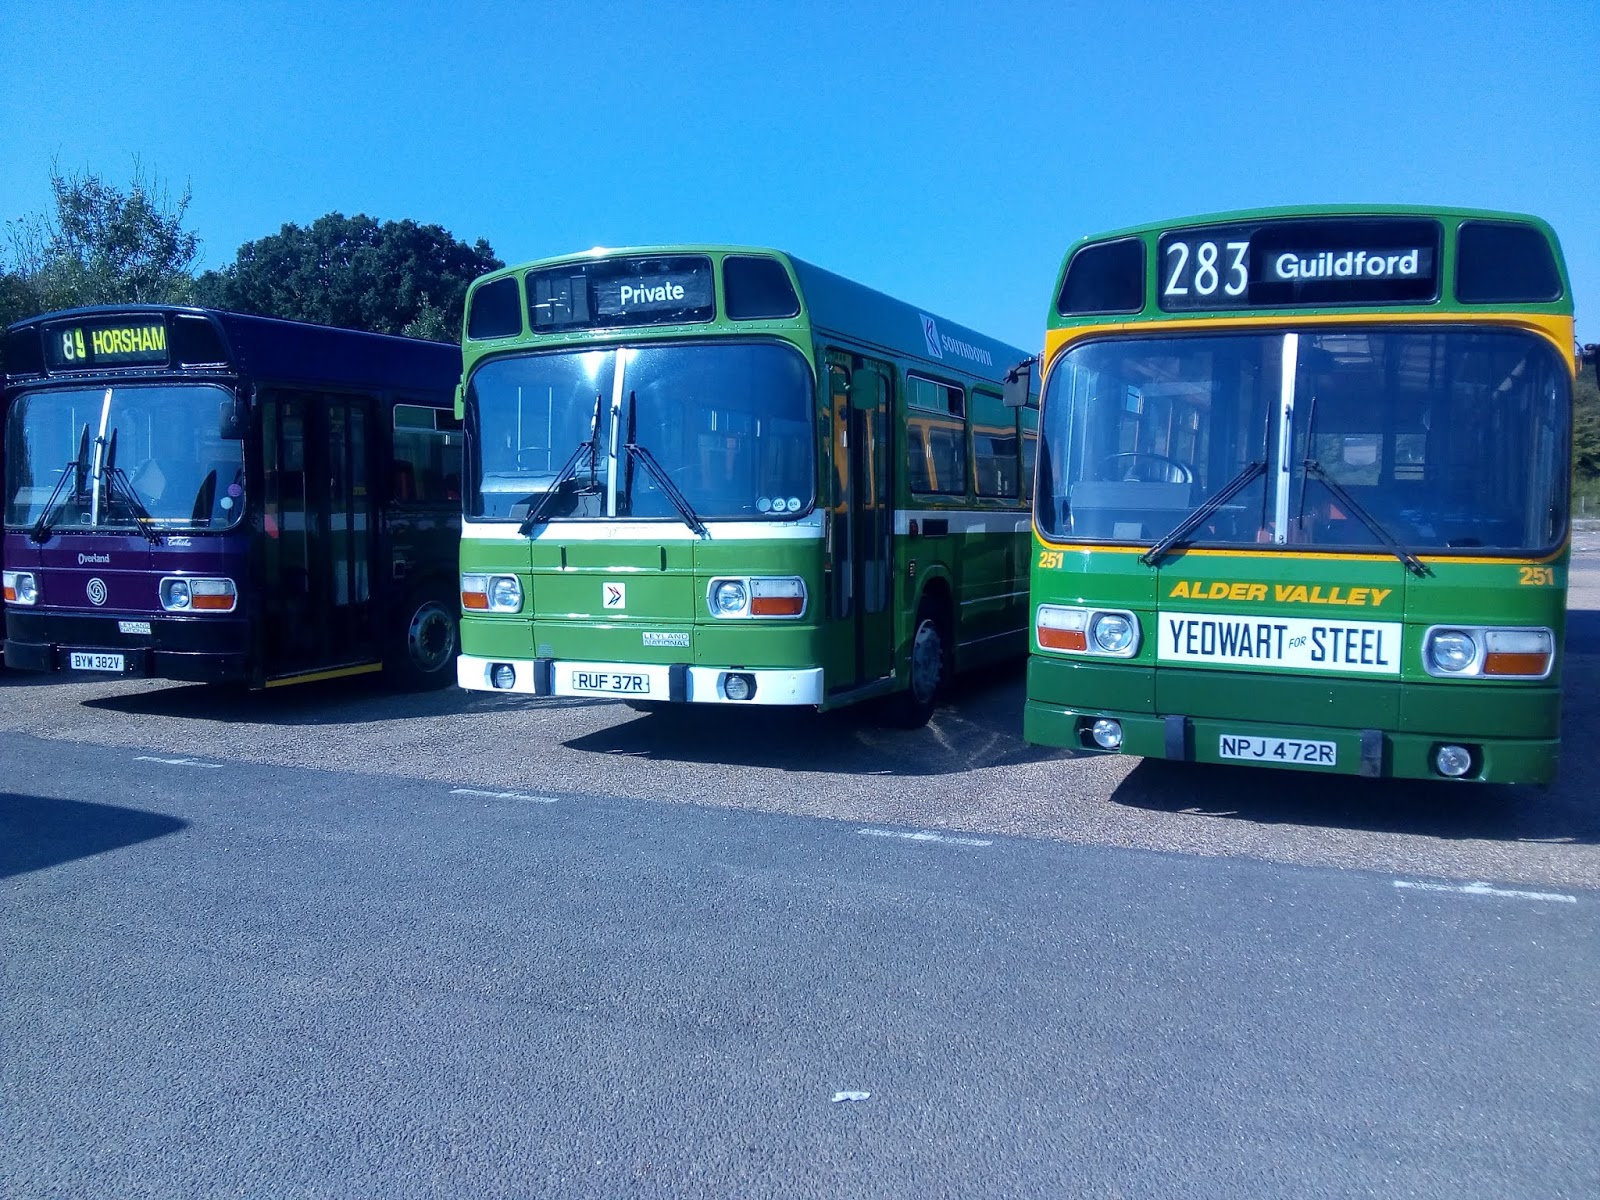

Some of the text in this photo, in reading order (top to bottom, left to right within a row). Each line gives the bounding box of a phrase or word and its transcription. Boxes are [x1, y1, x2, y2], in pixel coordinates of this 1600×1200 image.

[1164, 241, 1250, 296] 283
[1276, 249, 1419, 279] Guildford
[620, 281, 685, 306] Private
[92, 325, 166, 355] HORSHAM
[941, 333, 993, 367] SOUTHDOWN
[78, 552, 110, 565] Overland
[1038, 551, 1064, 569] 251
[1519, 566, 1554, 586] 251
[1169, 581, 1392, 607] ALDER VALLEY
[1169, 619, 1389, 666] YEOWART FOR STEEL
[75, 655, 120, 669] BYW 382V
[578, 673, 643, 691] RUF 37R
[1222, 738, 1334, 763] NPJ 472R
